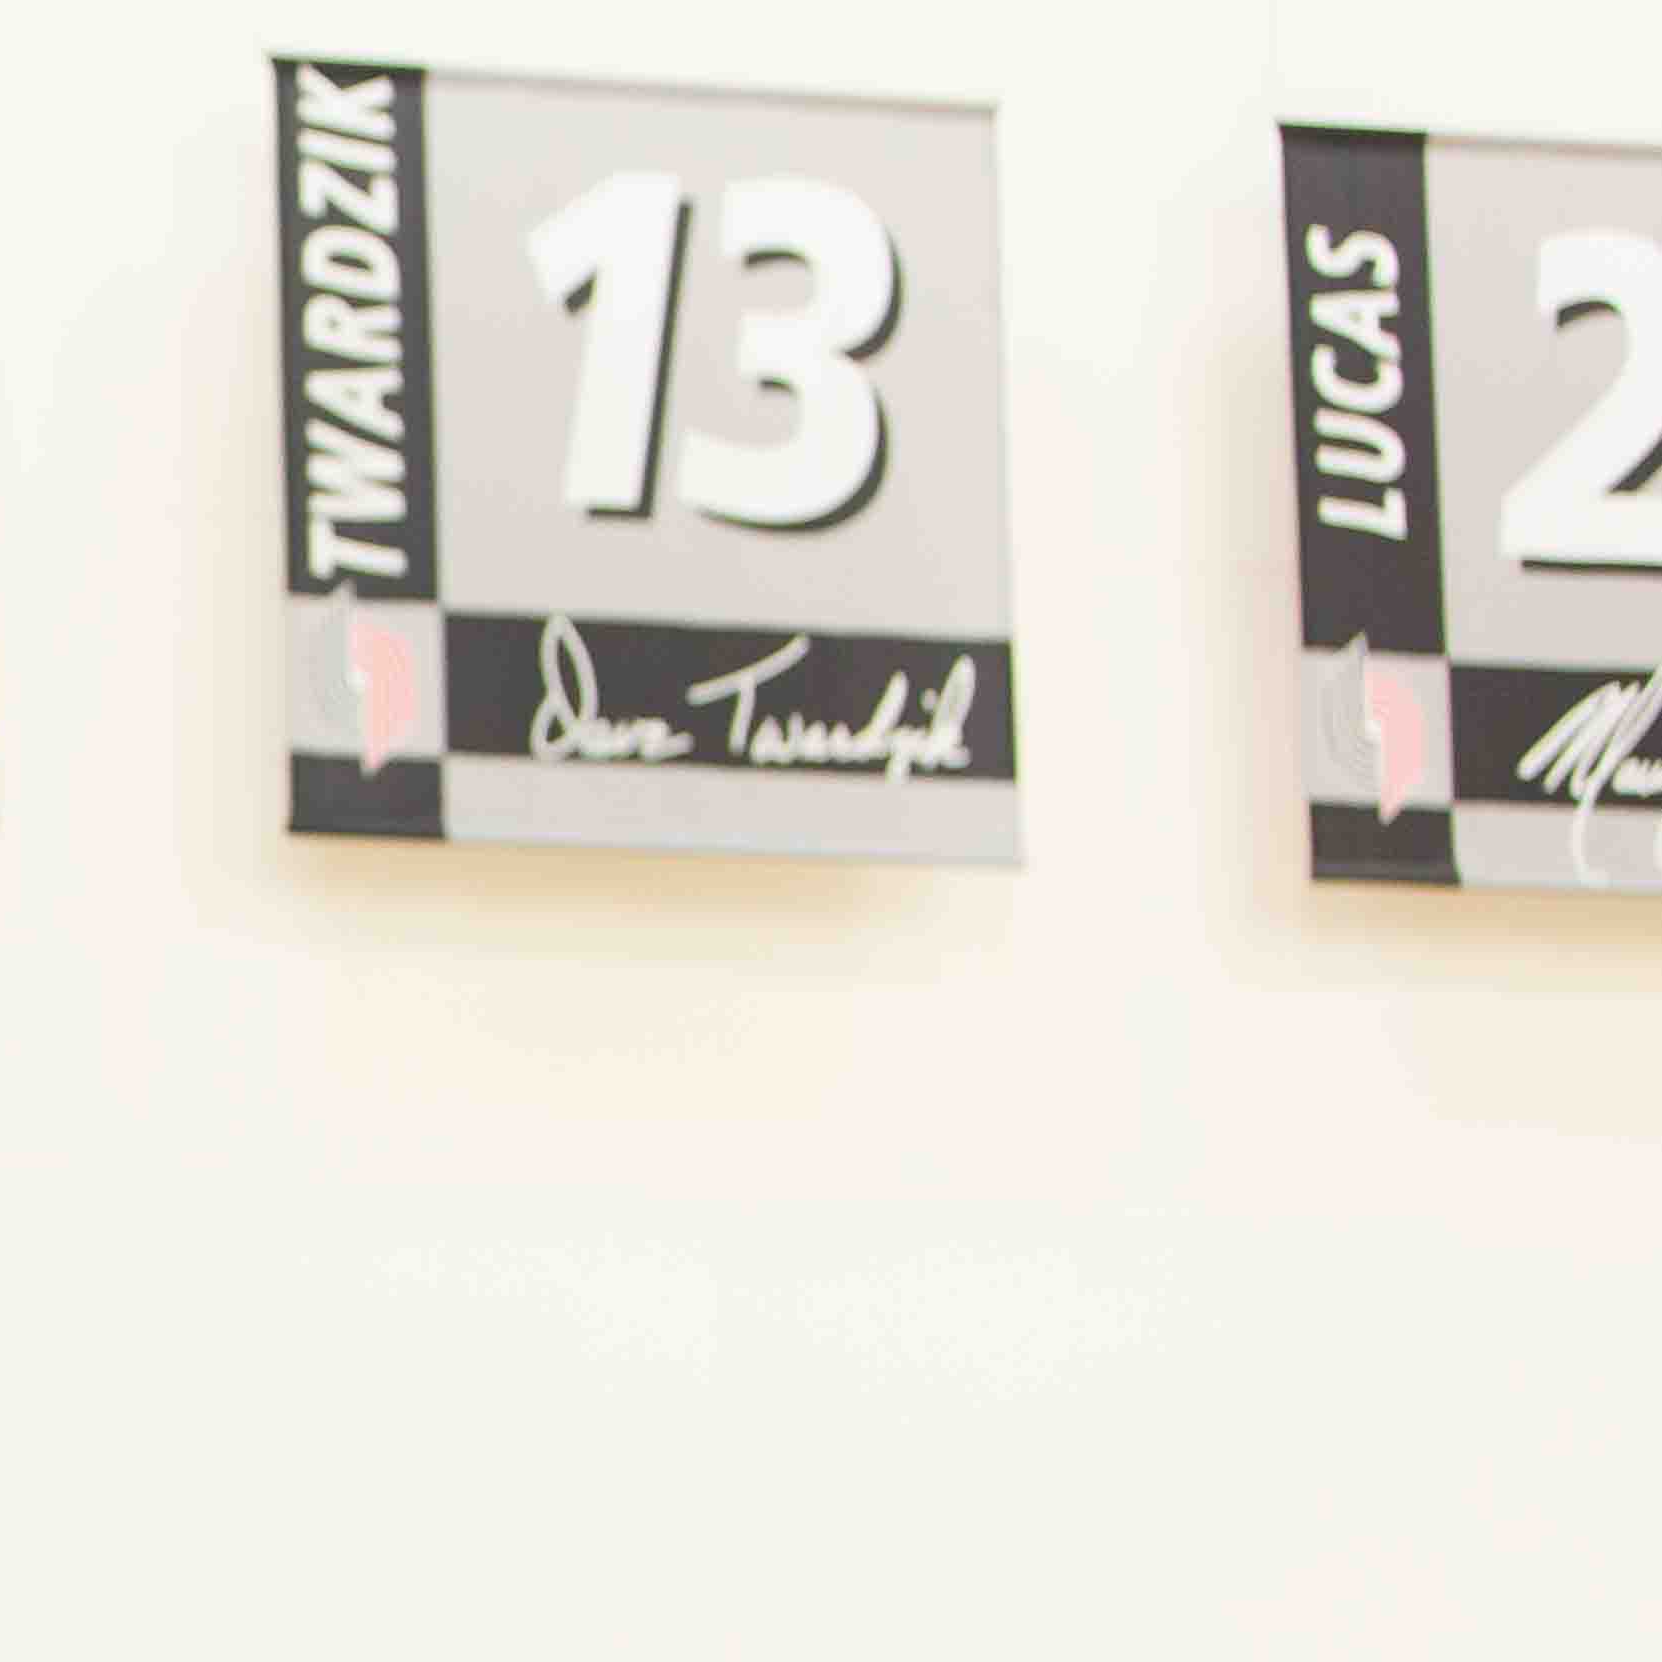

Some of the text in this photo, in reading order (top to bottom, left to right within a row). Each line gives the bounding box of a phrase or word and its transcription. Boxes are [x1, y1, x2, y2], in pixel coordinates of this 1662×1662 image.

[296, 62, 409, 581] TWARDZIK
[526, 168, 907, 533] 13
[1304, 223, 1409, 542] LUCAS
